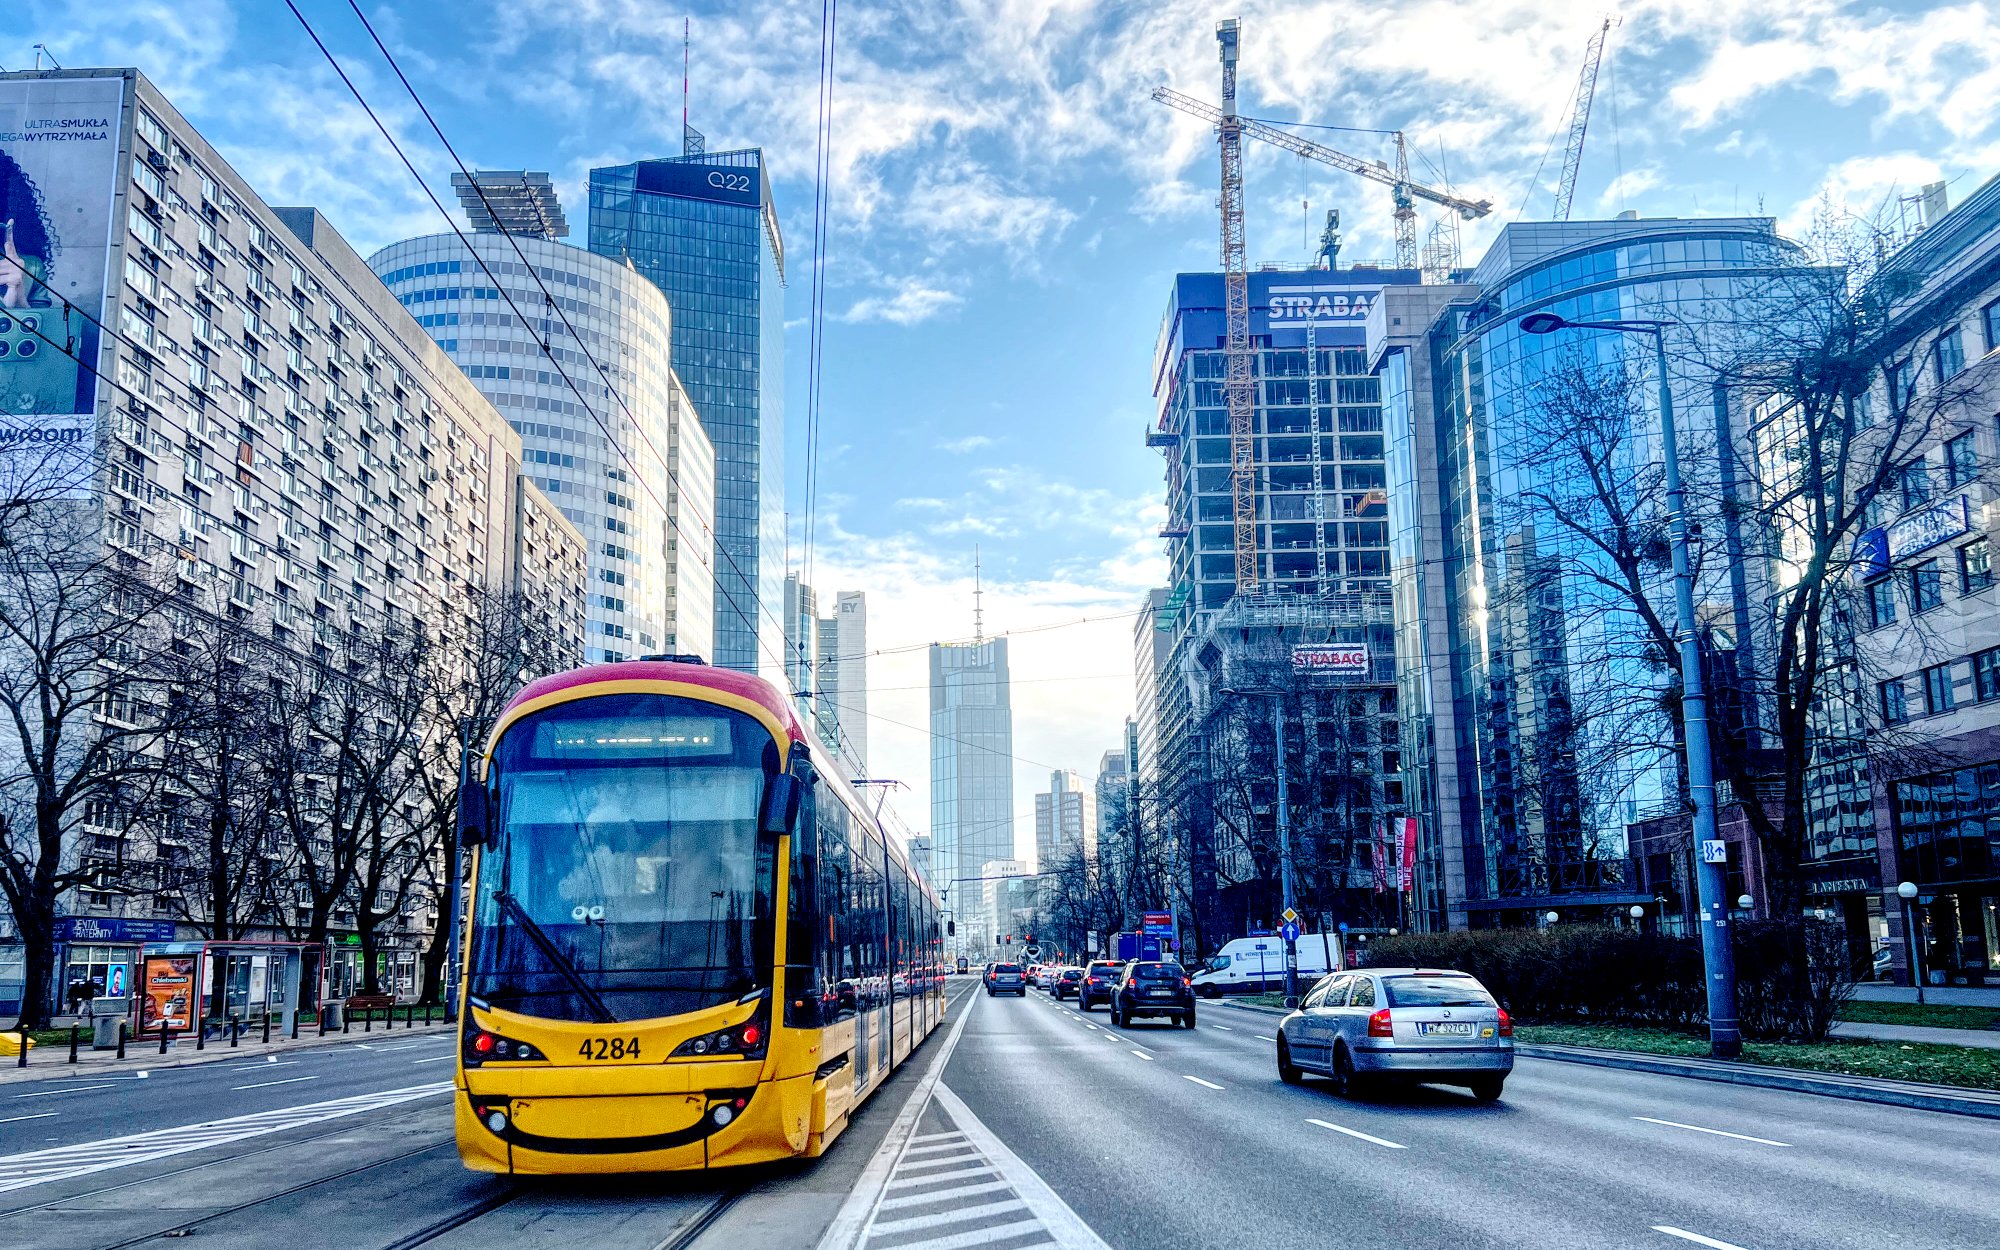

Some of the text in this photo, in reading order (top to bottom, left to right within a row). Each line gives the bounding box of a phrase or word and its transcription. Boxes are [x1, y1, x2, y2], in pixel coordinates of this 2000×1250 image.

[25, 119, 108, 128] ULTRASMUKŁA
[0, 132, 107, 141] EGAWYTRZYMAŁA
[708, 171, 750, 192] Q22
[842, 603, 858, 613] EY
[1295, 652, 1364, 665] STRABAG
[579, 1037, 641, 1060] 4284
